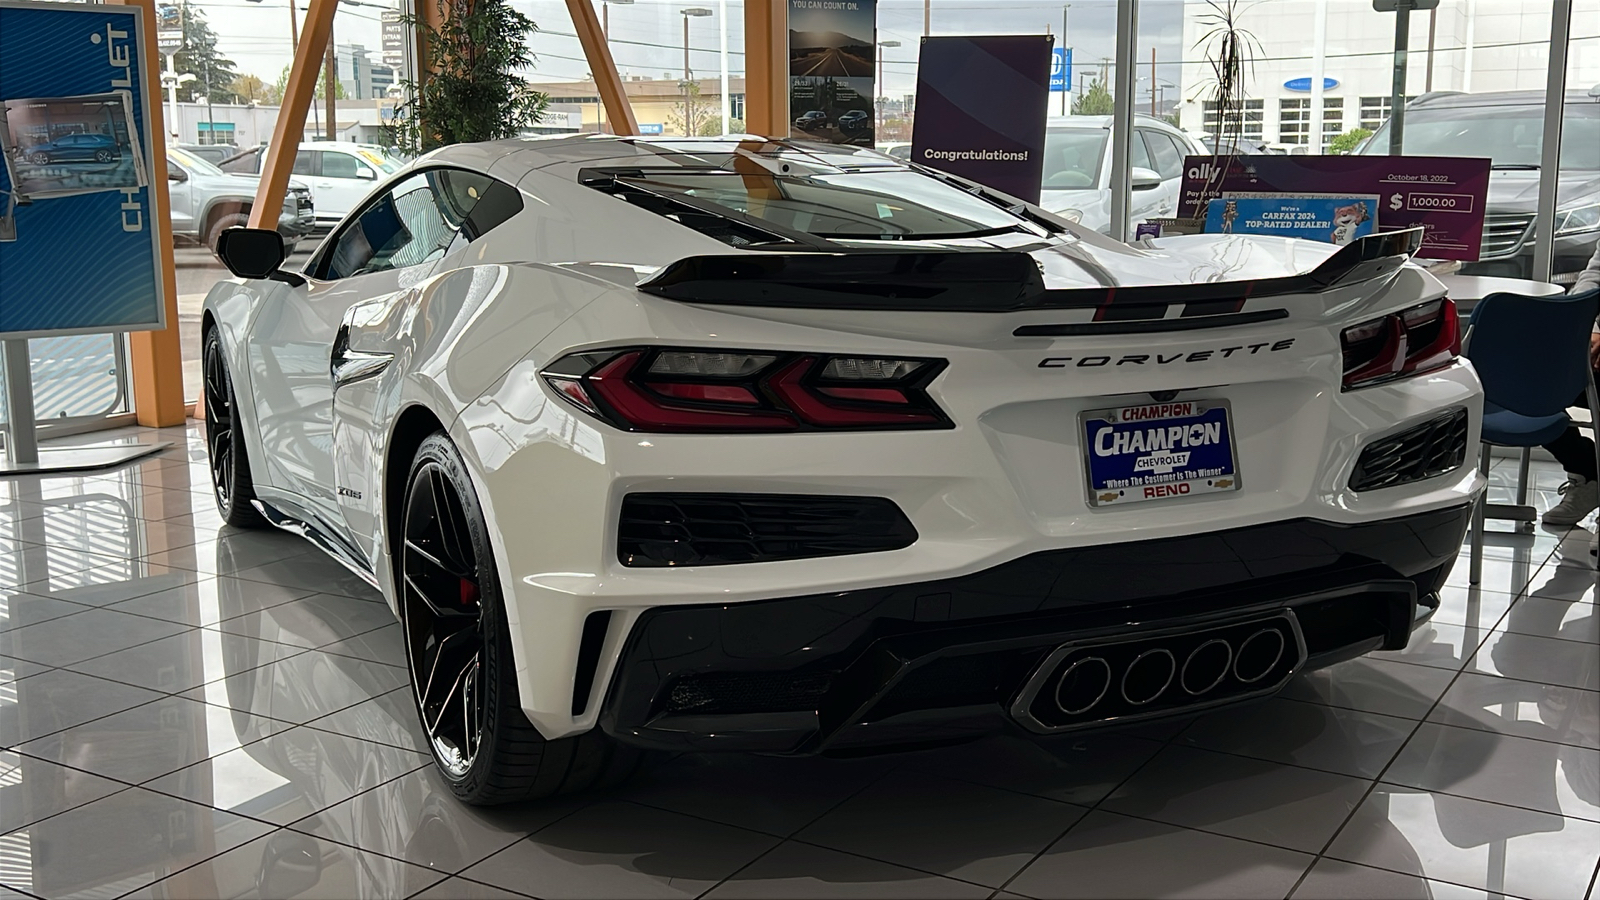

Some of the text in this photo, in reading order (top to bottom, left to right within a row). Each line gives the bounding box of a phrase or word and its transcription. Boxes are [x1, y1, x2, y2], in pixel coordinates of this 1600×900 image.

[793, 0, 859, 11] YOU CAN COUNT ON.
[923, 148, 1029, 162] Congratulations!
[1188, 163, 1221, 183] ally
[1387, 173, 1419, 181] October
[1186, 190, 1200, 198] Pay
[1389, 192, 1404, 212] $
[1411, 197, 1456, 207] 1,000.00
[1262, 212, 1316, 220] CARFAX 2024
[1245, 220, 1331, 229] TOP-RATED DEALER!
[1037, 338, 1296, 368] CORVETTE
[1122, 402, 1192, 421] CHAMPION
[1094, 421, 1221, 457] CHAMPION
[1137, 454, 1187, 468] CHEVROLET
[1130, 476, 1143, 486] The
[1144, 473, 1176, 484] Customer
[1177, 472, 1184, 480] Is
[1184, 470, 1197, 479] The
[1143, 482, 1191, 499] RENO
